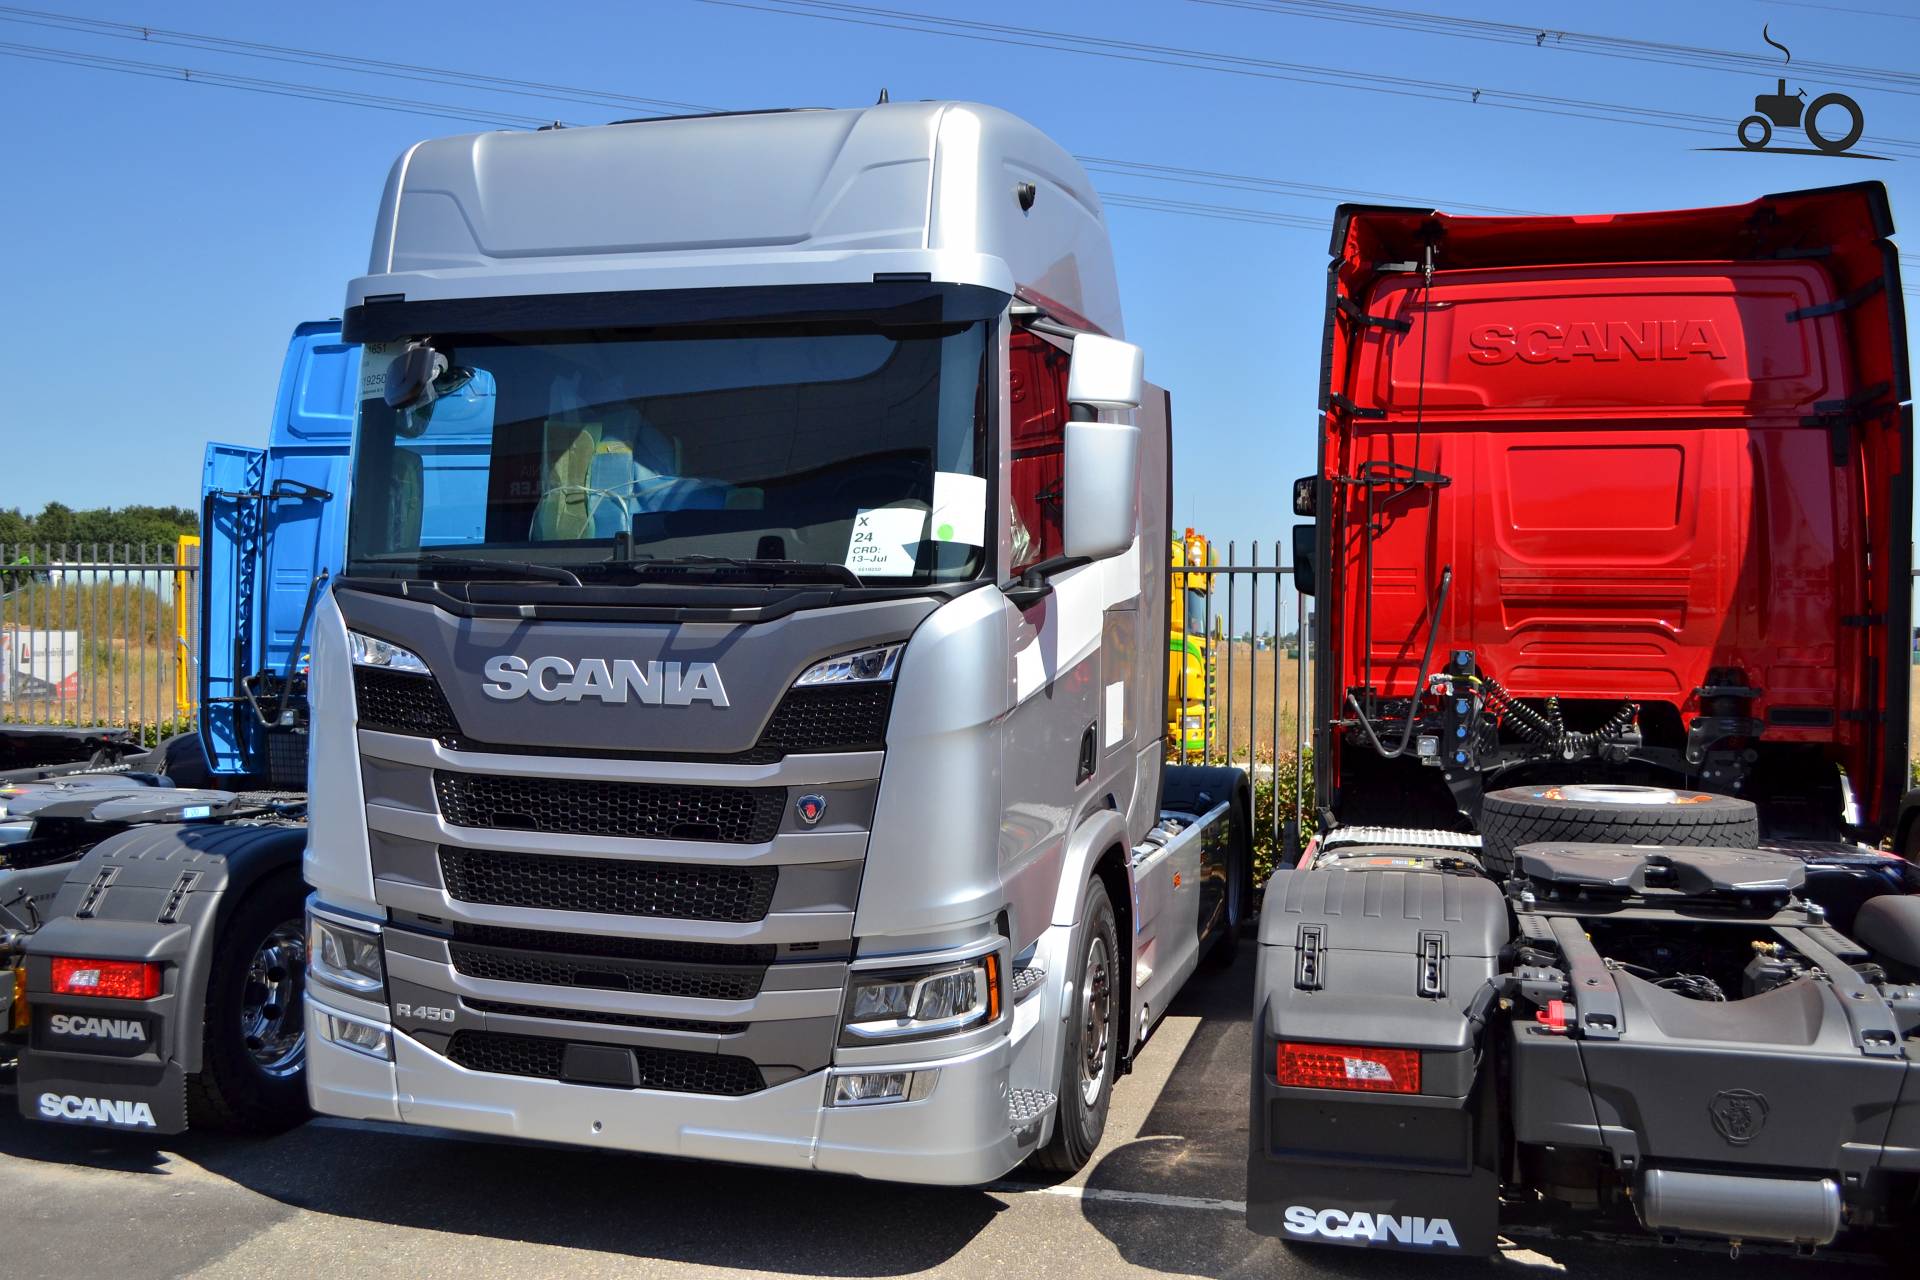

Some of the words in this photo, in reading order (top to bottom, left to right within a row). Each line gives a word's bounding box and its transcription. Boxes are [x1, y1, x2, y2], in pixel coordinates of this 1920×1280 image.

[1468, 320, 1727, 365] SCANIA
[858, 516, 870, 527] X
[852, 546, 881, 555] CRD:
[854, 532, 873, 543] 24
[482, 655, 730, 707] SCANIA
[396, 1003, 411, 1017] R
[413, 1006, 455, 1023] 450
[50, 1014, 146, 1041] SCANIA
[40, 1092, 157, 1127] SCANIA
[1283, 1205, 1460, 1247] SCANIA
